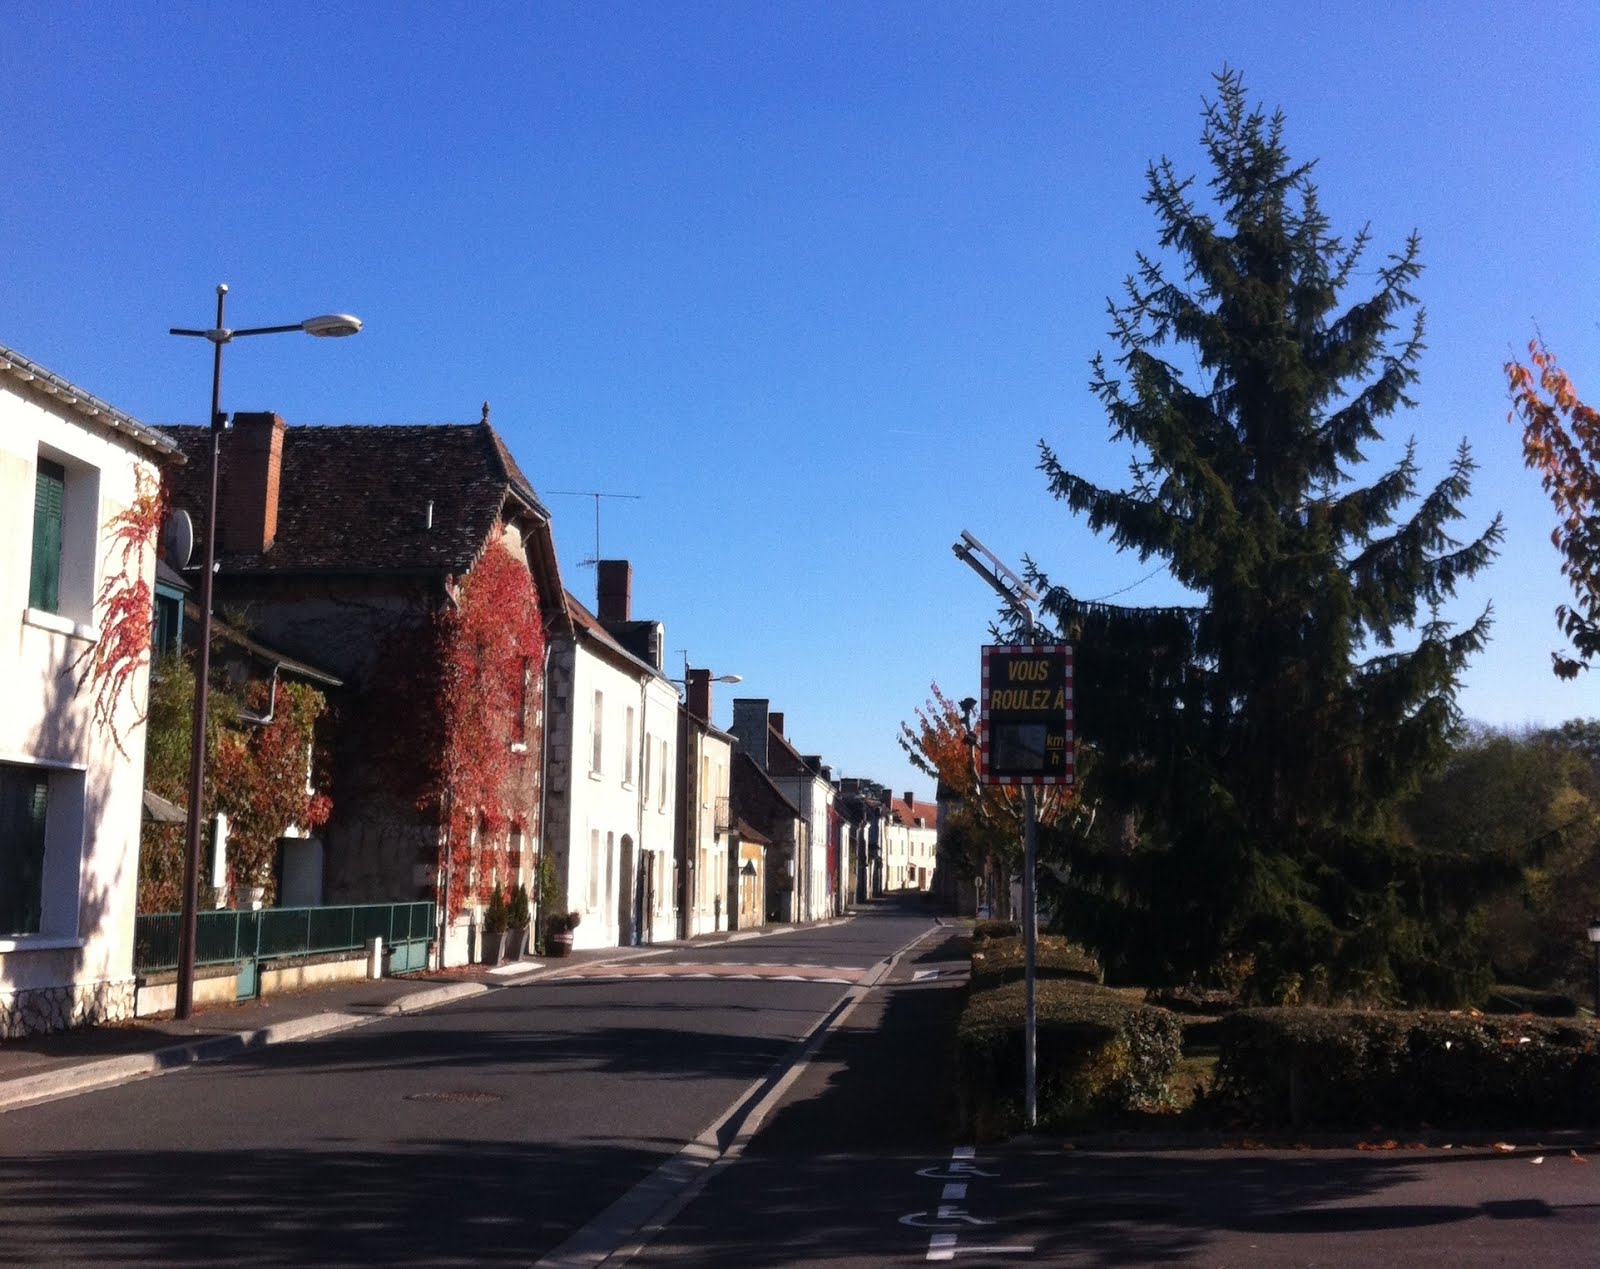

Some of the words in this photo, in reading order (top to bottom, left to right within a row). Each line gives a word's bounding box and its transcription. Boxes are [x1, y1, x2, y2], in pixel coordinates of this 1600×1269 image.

[1008, 660, 1049, 681] VOUS
[991, 689, 1050, 710] ROULEZ
[1046, 733, 1064, 747] km
[1051, 752, 1059, 765] h
